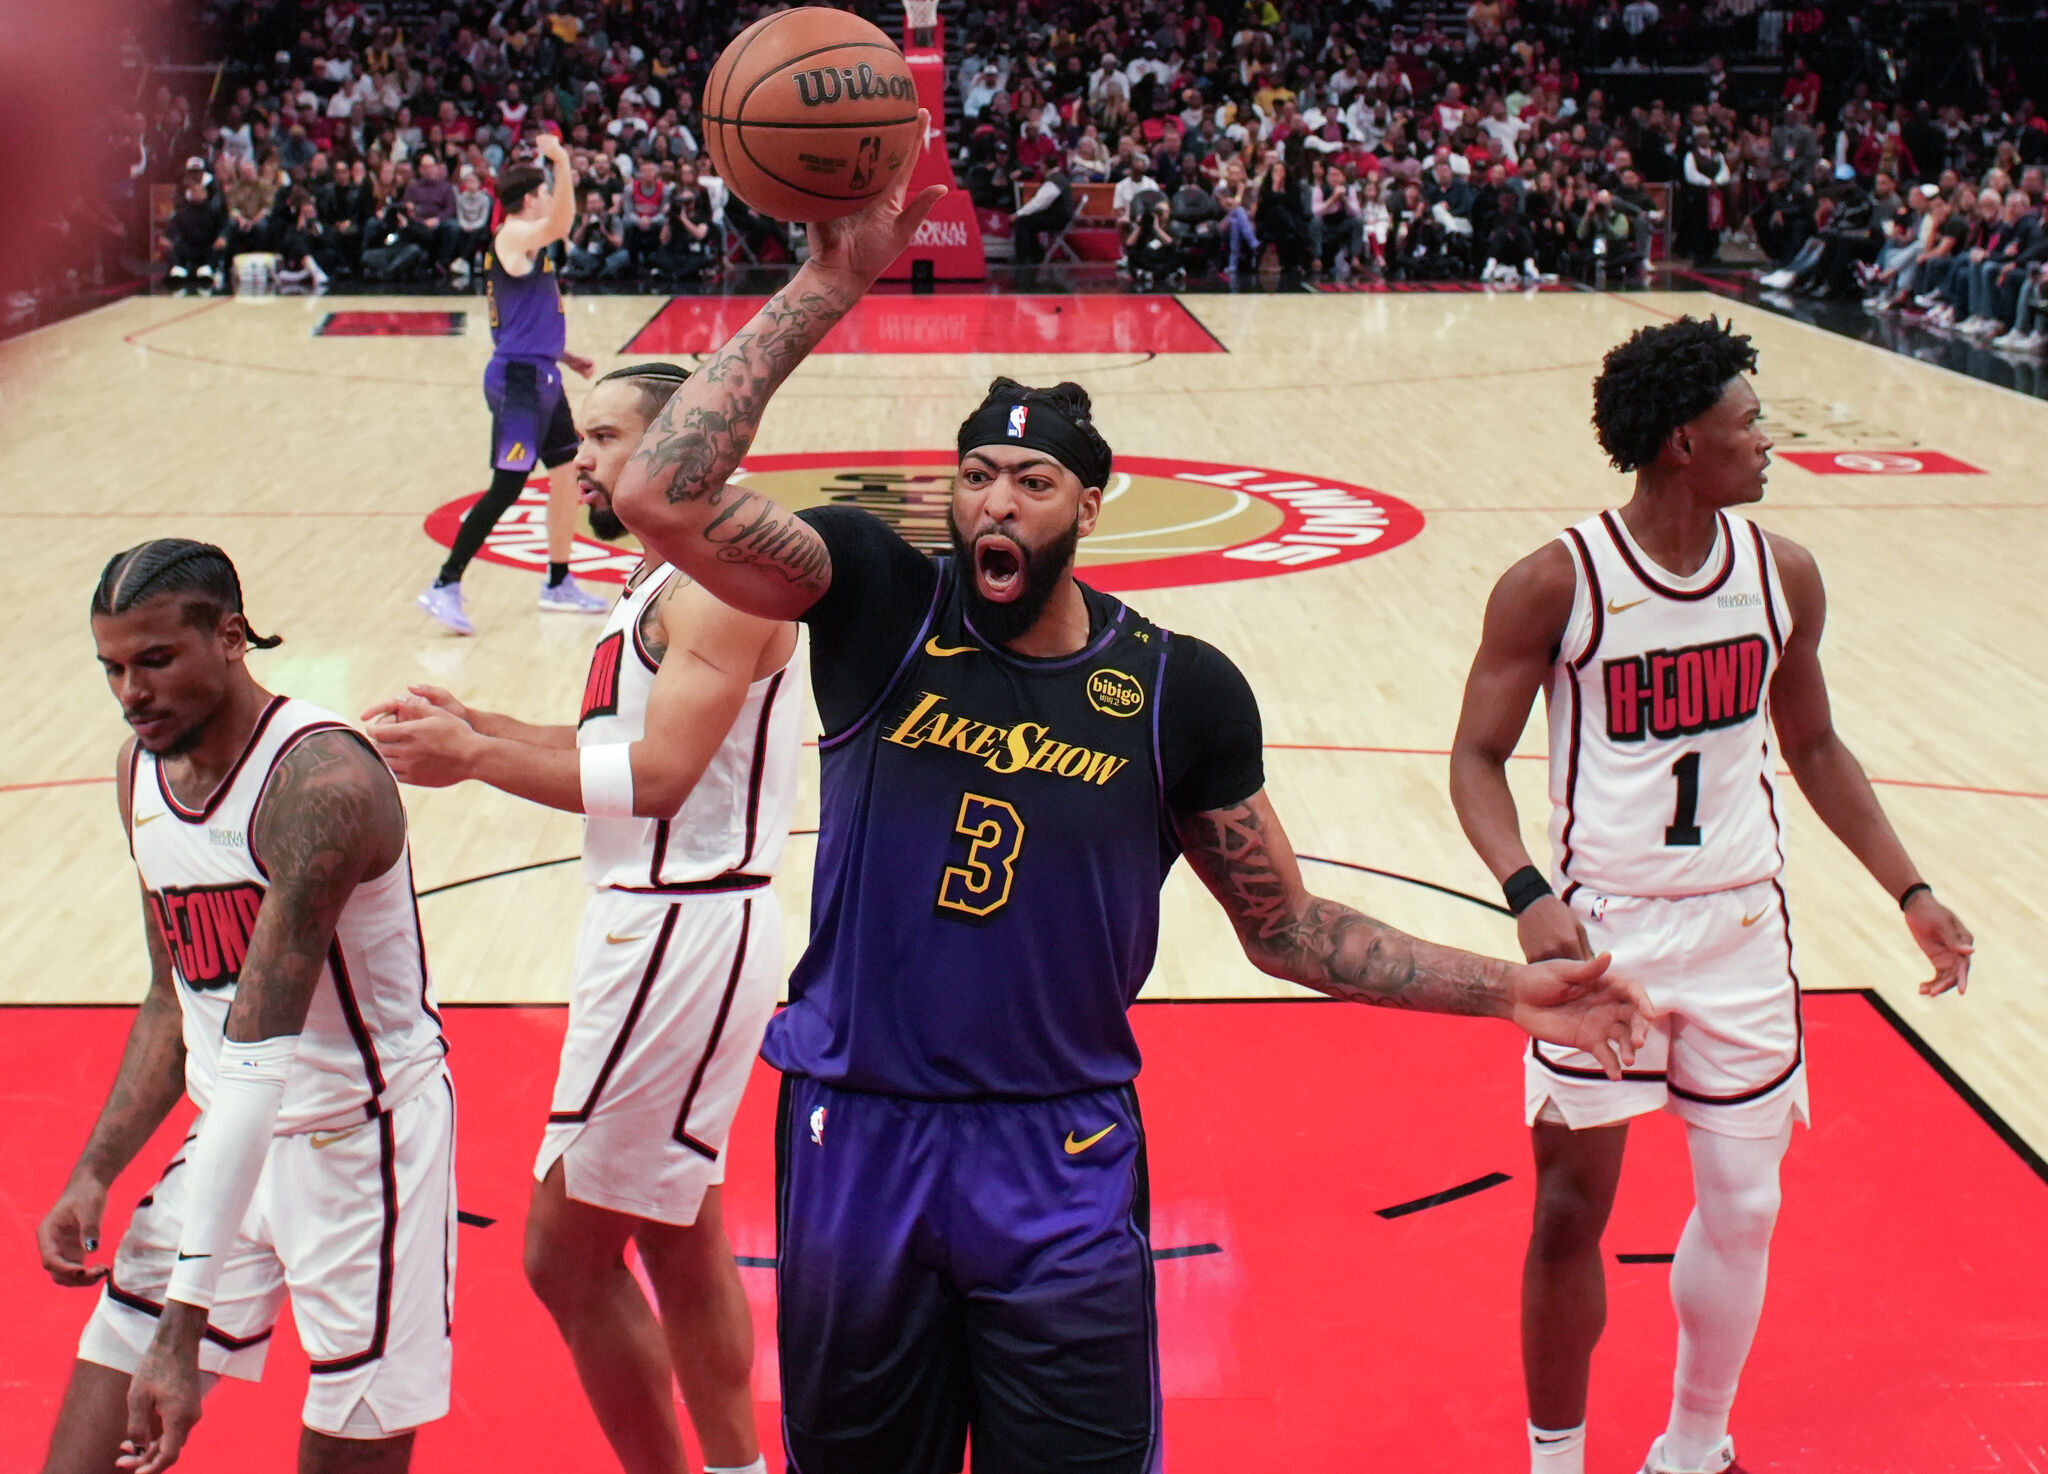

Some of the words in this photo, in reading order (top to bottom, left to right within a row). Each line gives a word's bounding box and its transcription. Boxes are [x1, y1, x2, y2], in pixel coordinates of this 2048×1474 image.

[791, 62, 917, 107] Wilson
[918, 219, 966, 234] ORIAL
[1173, 470, 1390, 566] SUMMIT
[1093, 677, 1140, 706] bibigo
[1664, 751, 1702, 847] 1
[937, 791, 1026, 917] 3
